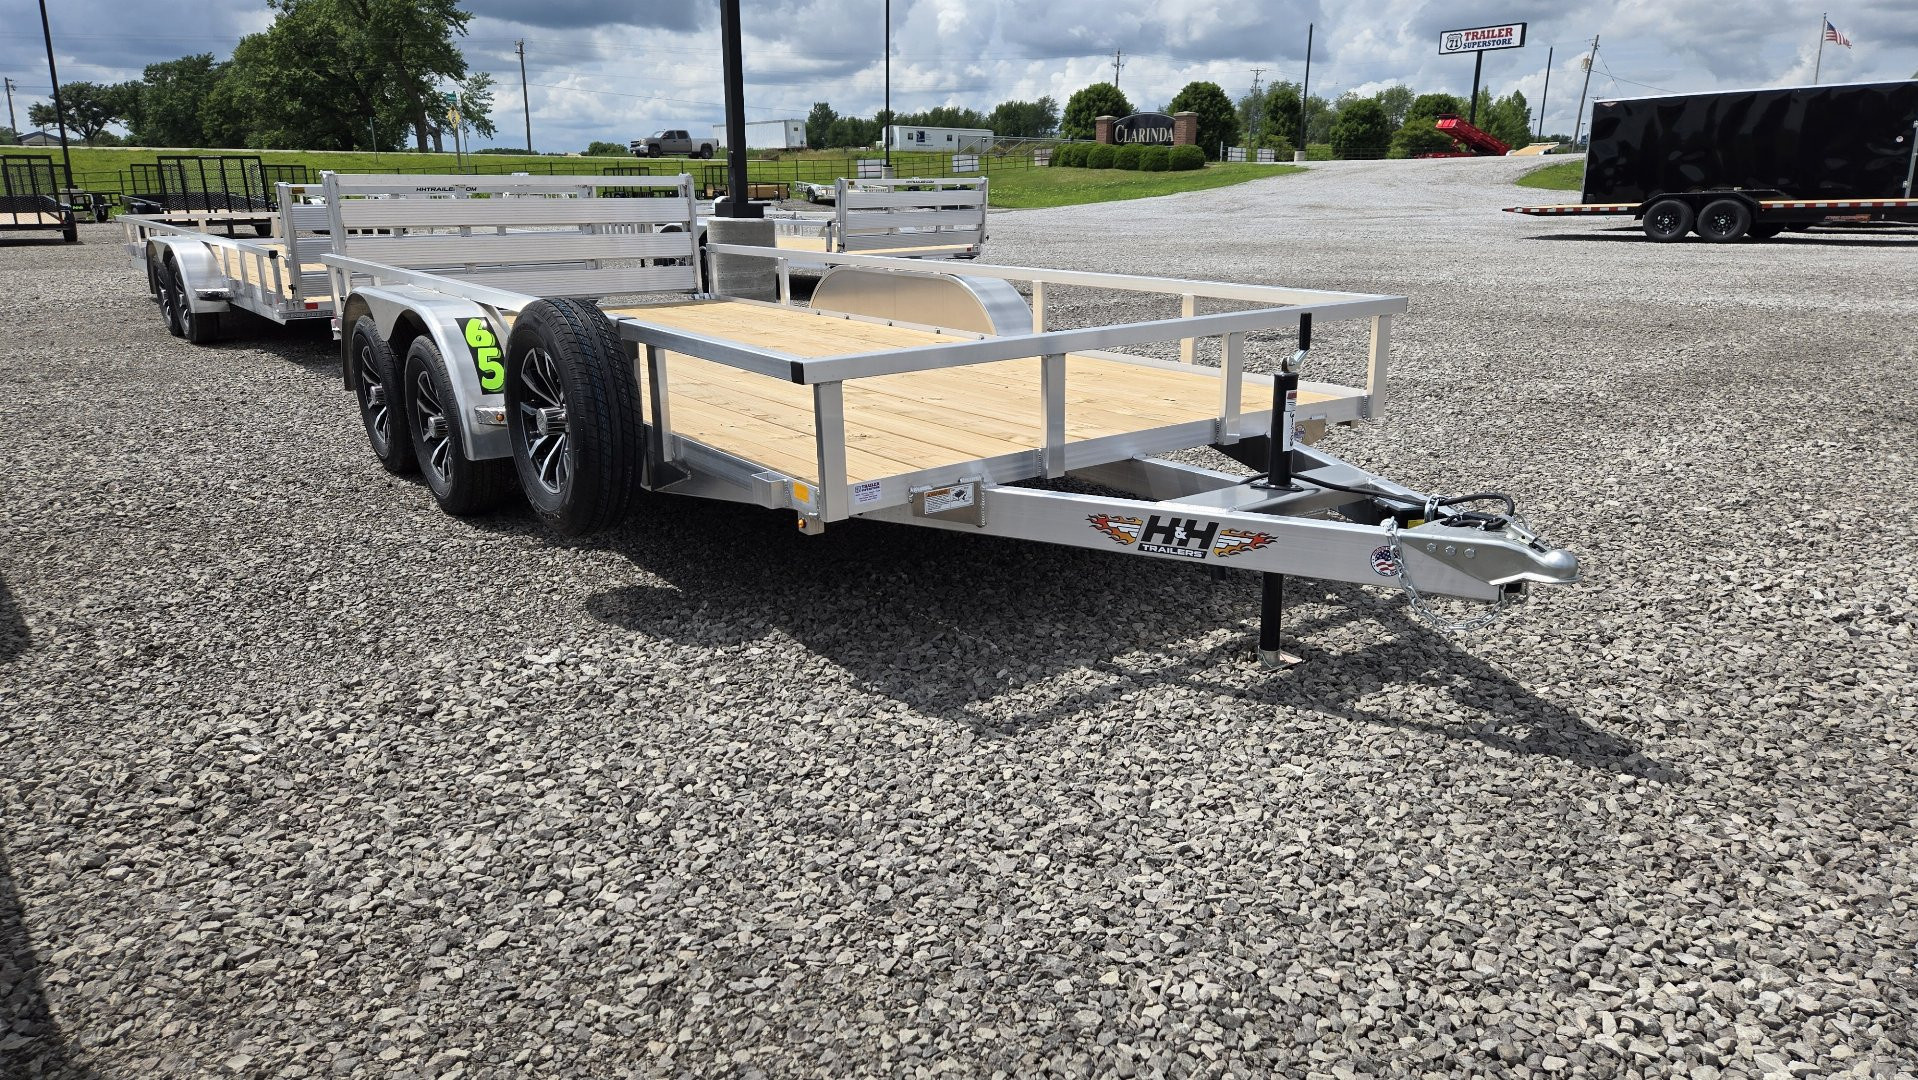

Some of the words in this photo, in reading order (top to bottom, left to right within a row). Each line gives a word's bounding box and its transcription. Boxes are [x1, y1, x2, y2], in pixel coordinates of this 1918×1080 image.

[1464, 28, 1513, 41] TRAILER
[1449, 39, 1459, 48] 71
[1463, 38, 1513, 49] SUPERSTORE
[1114, 124, 1174, 143] CLARINDA
[1140, 514, 1219, 550] H&H
[1142, 543, 1204, 559] TRAILERS
